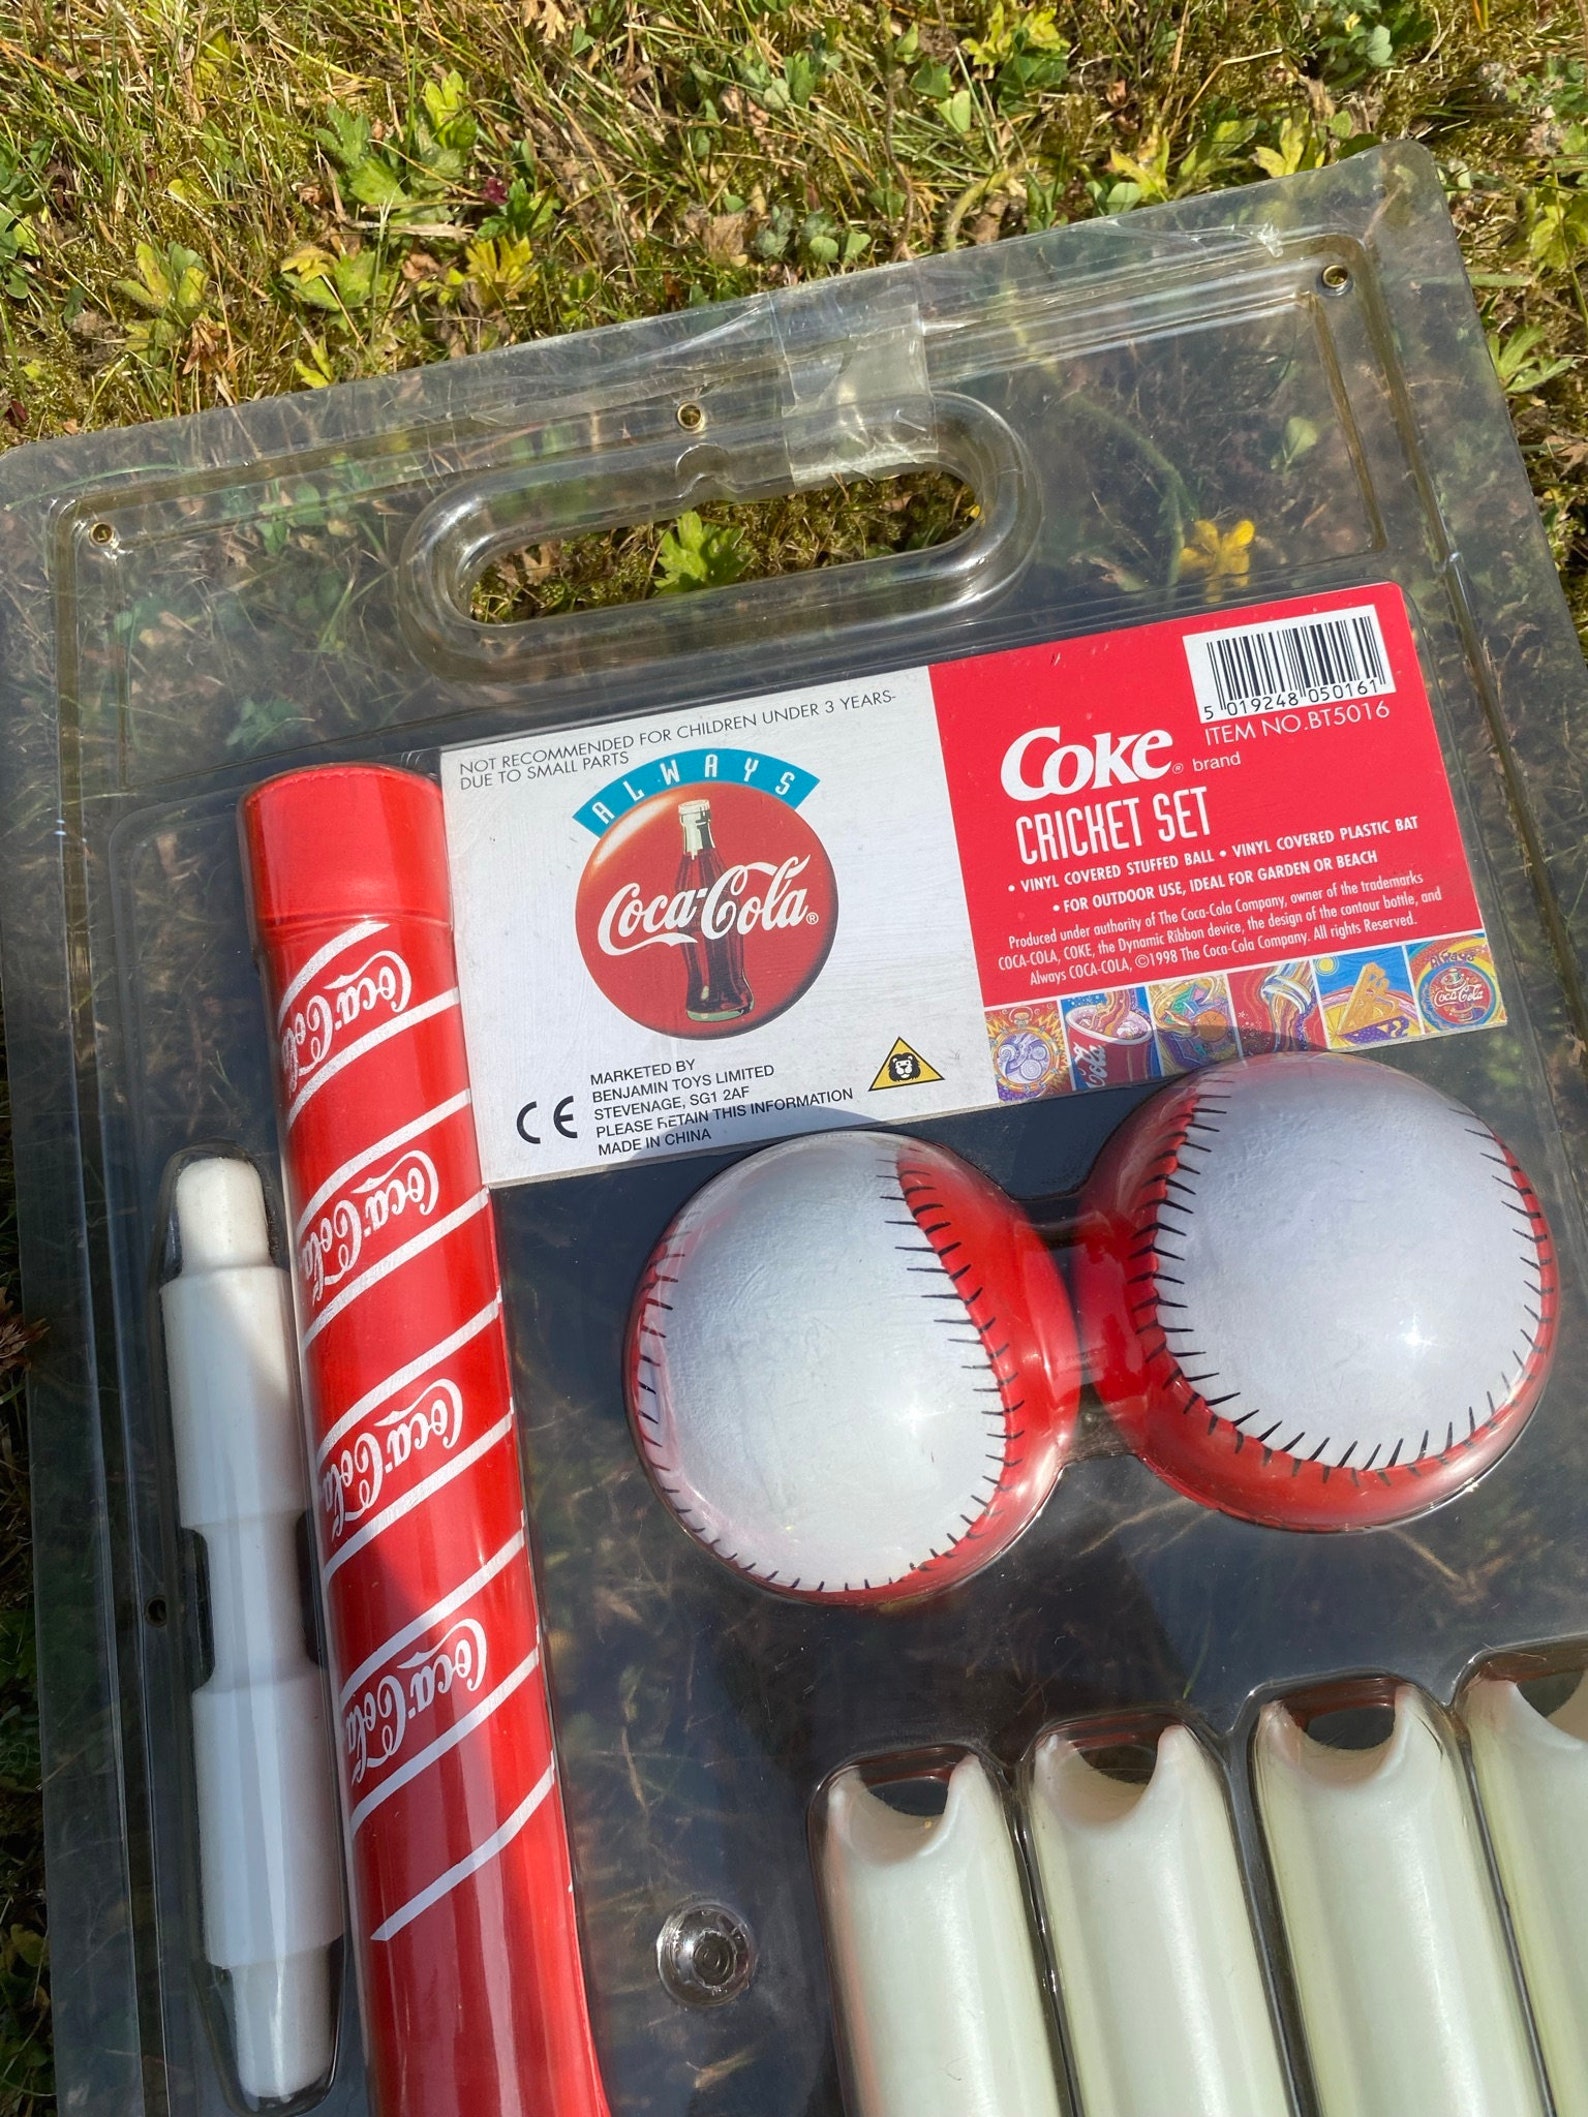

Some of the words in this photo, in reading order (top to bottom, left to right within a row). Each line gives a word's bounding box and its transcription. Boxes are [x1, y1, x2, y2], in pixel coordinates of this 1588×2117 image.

[1204, 705, 1214, 720] 5
[1227, 693, 1299, 716] 019248
[1308, 679, 1378, 702] 050161
[460, 757, 497, 775] NOT
[502, 735, 634, 768] RECOMMENDED
[639, 728, 672, 745] FOR
[677, 713, 757, 739] CHILDREN
[762, 703, 820, 724] UNDER
[825, 700, 835, 713] 3
[1204, 721, 1257, 746] ITEM
[460, 773, 492, 790] DUE
[498, 769, 521, 784] TO
[527, 759, 578, 779] SMALL
[582, 751, 629, 770] PARTS
[1192, 752, 1241, 772] brand
[592, 753, 795, 825] ALWAYS
[1015, 797, 1143, 865] CRICKET
[1152, 786, 1211, 842] SET
[1020, 874, 1060, 893] VINYL
[1064, 864, 1121, 885] COVERED
[1126, 855, 1178, 875] STUFFED
[1183, 849, 1215, 866] BALL
[1232, 840, 1272, 858] VINYL
[1276, 830, 1335, 850] COVERED
[1339, 820, 1391, 841] PLASTIC
[1395, 816, 1419, 832] BAT
[1063, 898, 1089, 913] FOR
[1092, 886, 1156, 907] OUTDOOR
[1158, 880, 1186, 897] USE,
[1189, 874, 1225, 893] IDEAL
[1228, 870, 1254, 886] FOR
[1257, 860, 1311, 881] GARDEN
[1314, 856, 1333, 871] OR
[1337, 850, 1378, 869] BEACH
[998, 949, 1061, 971] COCA-COLA,
[1063, 943, 1095, 960] COKE,
[1097, 940, 1115, 955] the
[1118, 932, 1164, 953] Dynamic
[1166, 927, 1204, 944] Ribbon
[1207, 921, 1245, 937] device,
[1247, 916, 1265, 931] the
[1268, 912, 1303, 928] design
[1305, 906, 1317, 922] of
[1319, 905, 1337, 919] the
[1340, 901, 1380, 916] contour
[1383, 891, 1419, 909] bottle,
[1421, 886, 1442, 903] and
[1008, 928, 1057, 949] Produced
[1060, 924, 1090, 942] under
[1094, 917, 1142, 936] authority
[1145, 912, 1156, 927] of
[1158, 911, 1178, 925] The
[1181, 901, 1232, 921] Coca-Cola
[1235, 895, 1288, 914] Company,
[1290, 889, 1323, 904] owner
[1326, 883, 1338, 898] of
[1341, 881, 1358, 895] the
[1361, 870, 1424, 892] trademarks
[1030, 970, 1067, 986] Always
[1069, 958, 1133, 979] COCA-COLA,
[1180, 947, 1200, 962] The
[1203, 937, 1254, 957] Coca-Cola
[1257, 931, 1311, 949] Company.
[1313, 925, 1327, 941] All
[1330, 921, 1362, 940] rights
[1364, 911, 1417, 933] Reserved.
[590, 1062, 672, 1085] MARKETED
[676, 1058, 695, 1072] BY
[592, 1081, 668, 1103] BENJAMIN
[671, 1074, 711, 1089] TOYS
[716, 1064, 774, 1084] LIMITED
[594, 1096, 686, 1121] STEVENAGE,
[690, 1091, 717, 1106] SG1
[723, 1085, 750, 1101] 2AF
[596, 1118, 654, 1138] PLEASE
[657, 1110, 708, 1129] RETAIN
[713, 1104, 747, 1120] THIS
[751, 1087, 853, 1115] INFORMATION
[598, 1140, 642, 1156] MADE
[646, 1136, 660, 1149] IN
[665, 1128, 711, 1146] CHINA
